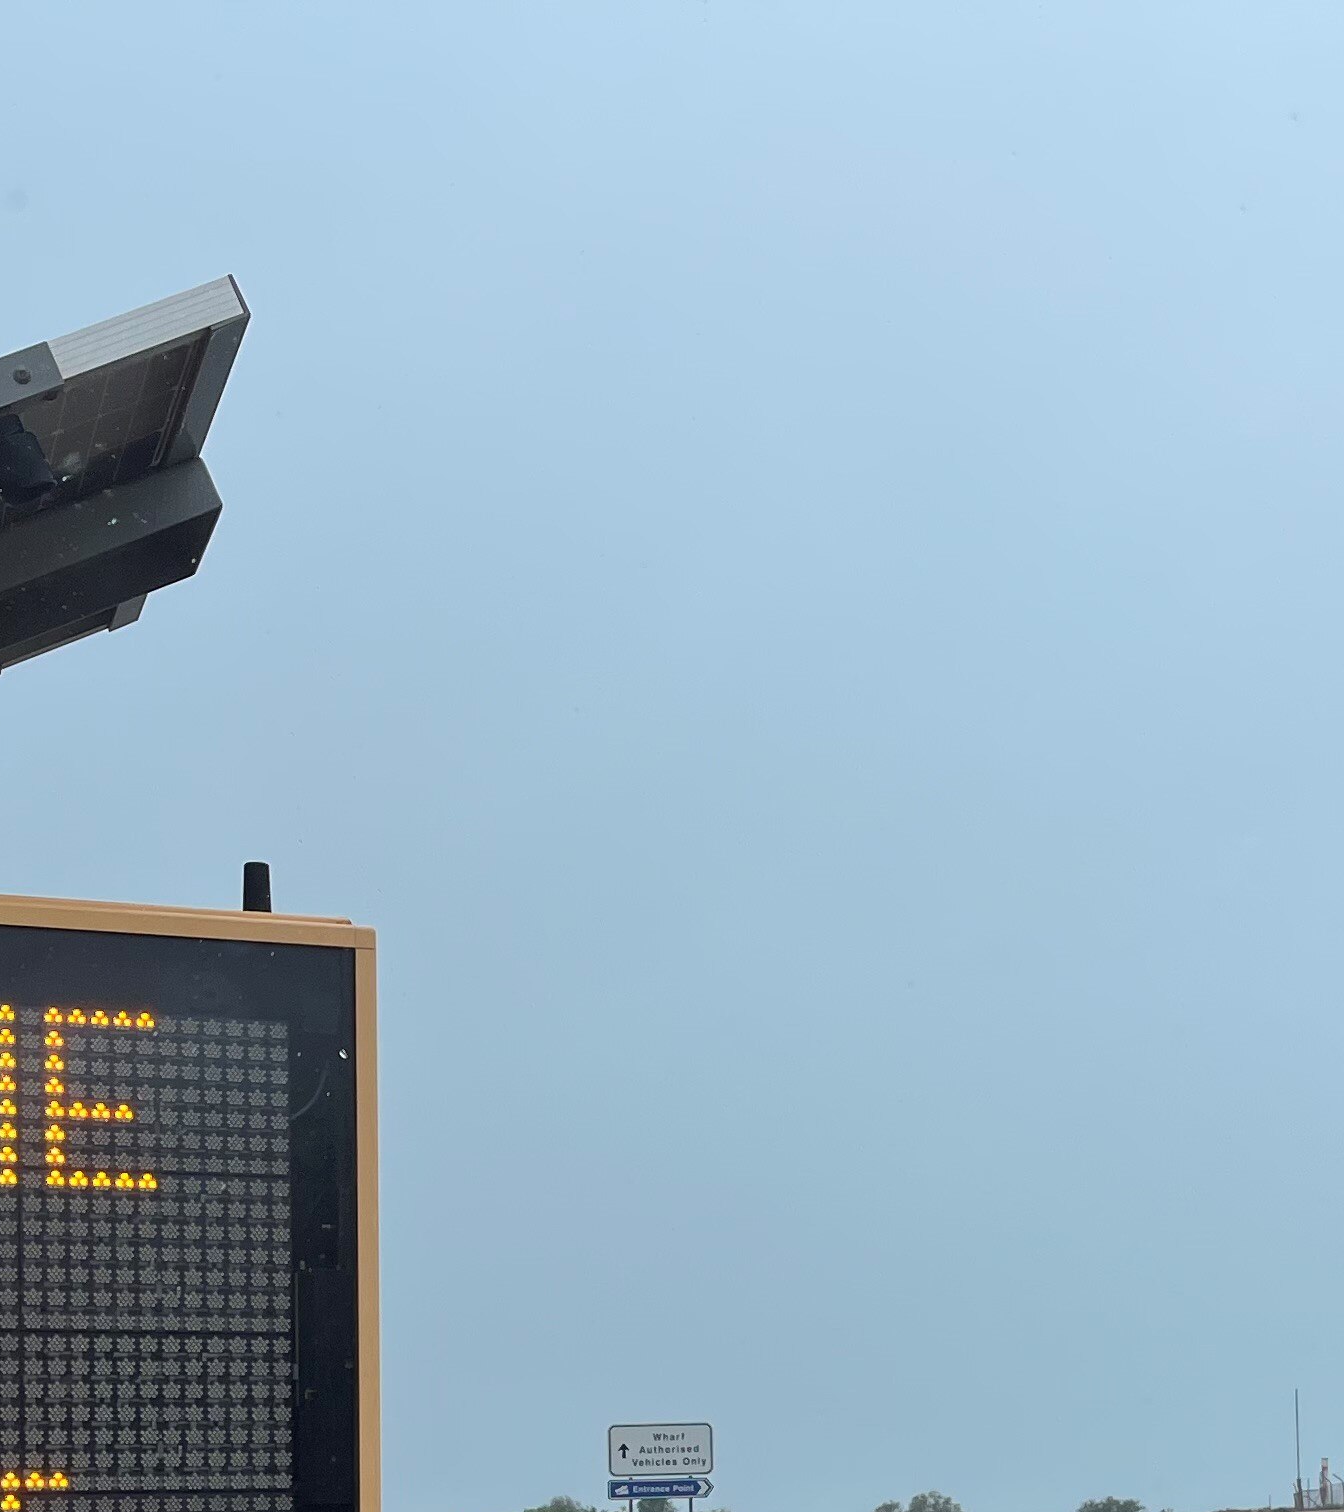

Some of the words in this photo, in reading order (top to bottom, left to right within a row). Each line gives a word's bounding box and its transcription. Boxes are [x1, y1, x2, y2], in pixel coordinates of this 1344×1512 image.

[652, 1432, 685, 1441] Wharf
[639, 1445, 700, 1454] Authorised
[632, 1458, 677, 1467] Vehicles
[683, 1457, 706, 1467] Only
[632, 1485, 670, 1493] Entrance
[672, 1484, 695, 1492] Point
